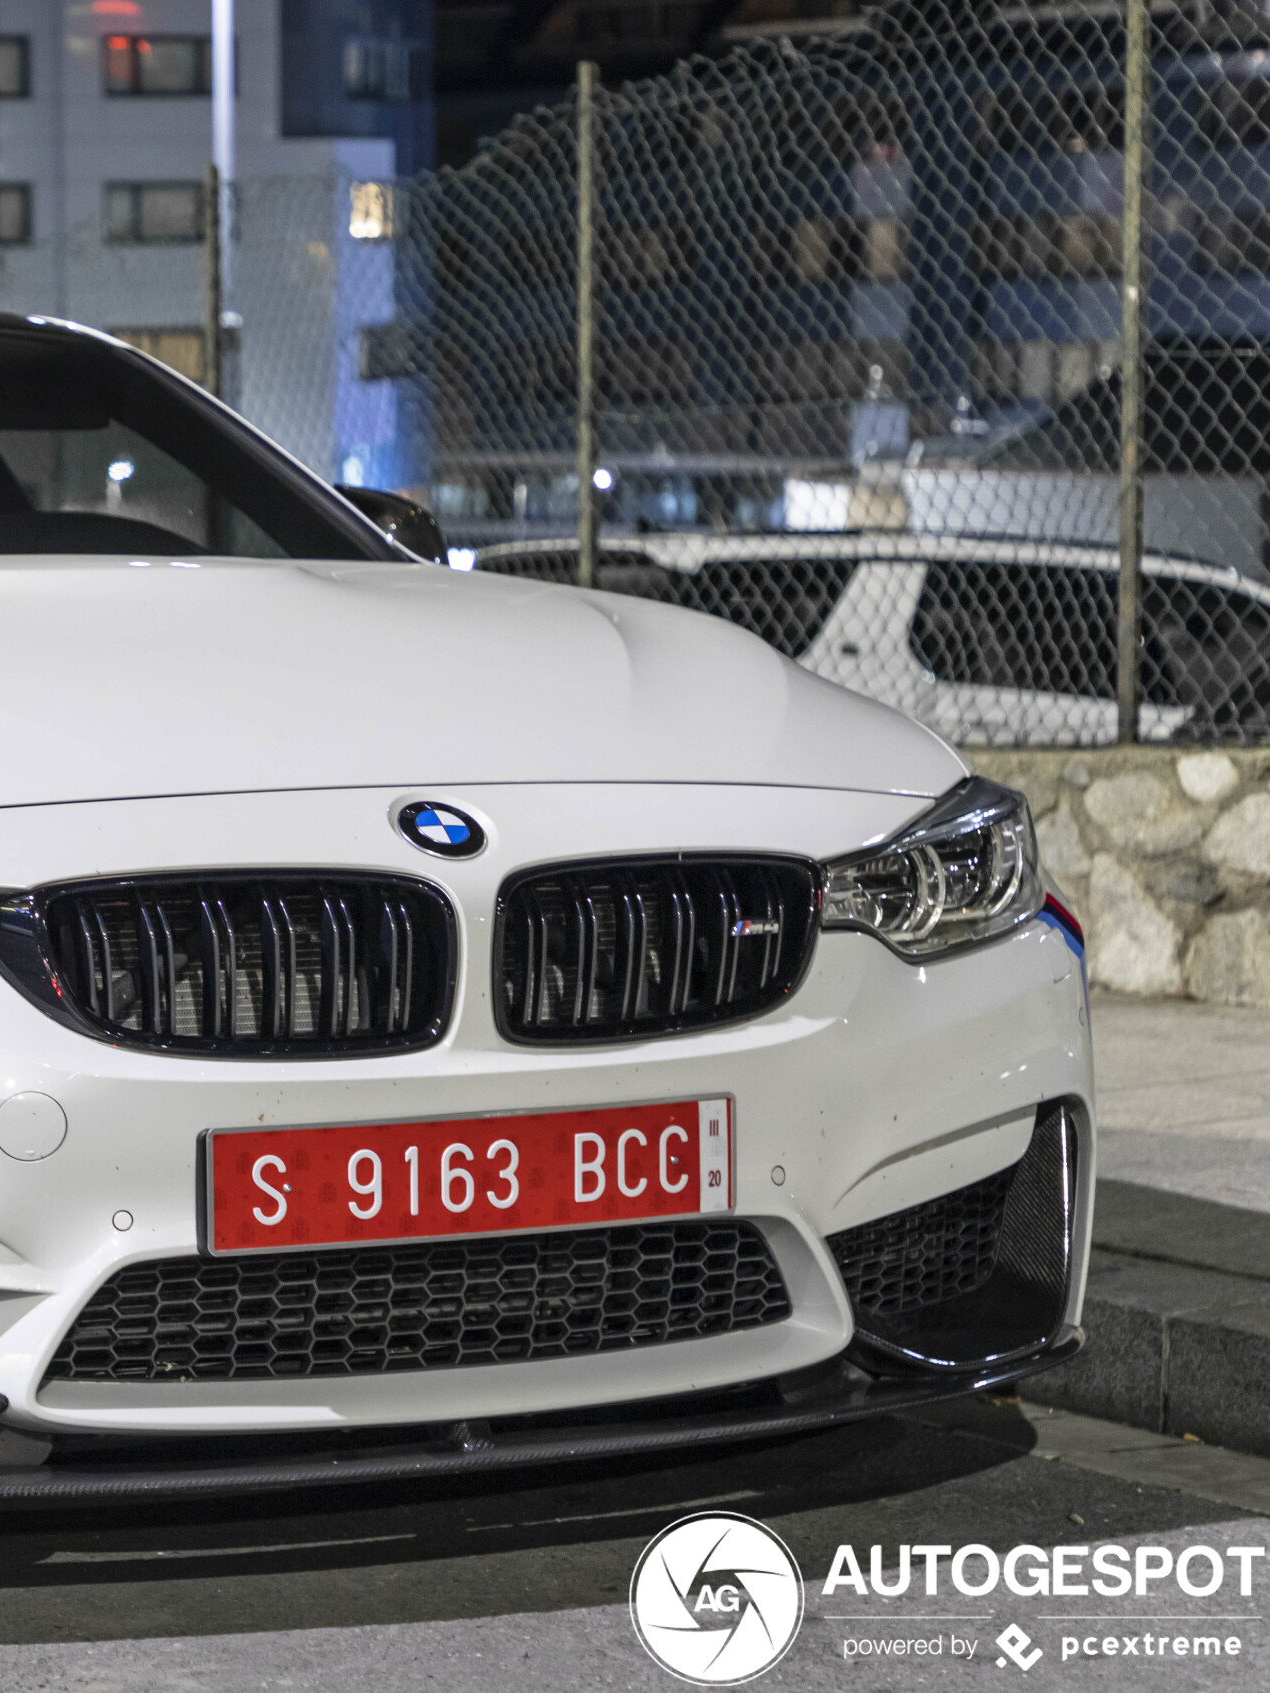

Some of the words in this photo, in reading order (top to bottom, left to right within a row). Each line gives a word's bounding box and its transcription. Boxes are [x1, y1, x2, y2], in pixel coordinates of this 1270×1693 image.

[251, 1153, 289, 1227] S
[346, 1138, 521, 1221] 9163
[573, 1124, 690, 1204] BCC
[708, 1169, 722, 1188] 20
